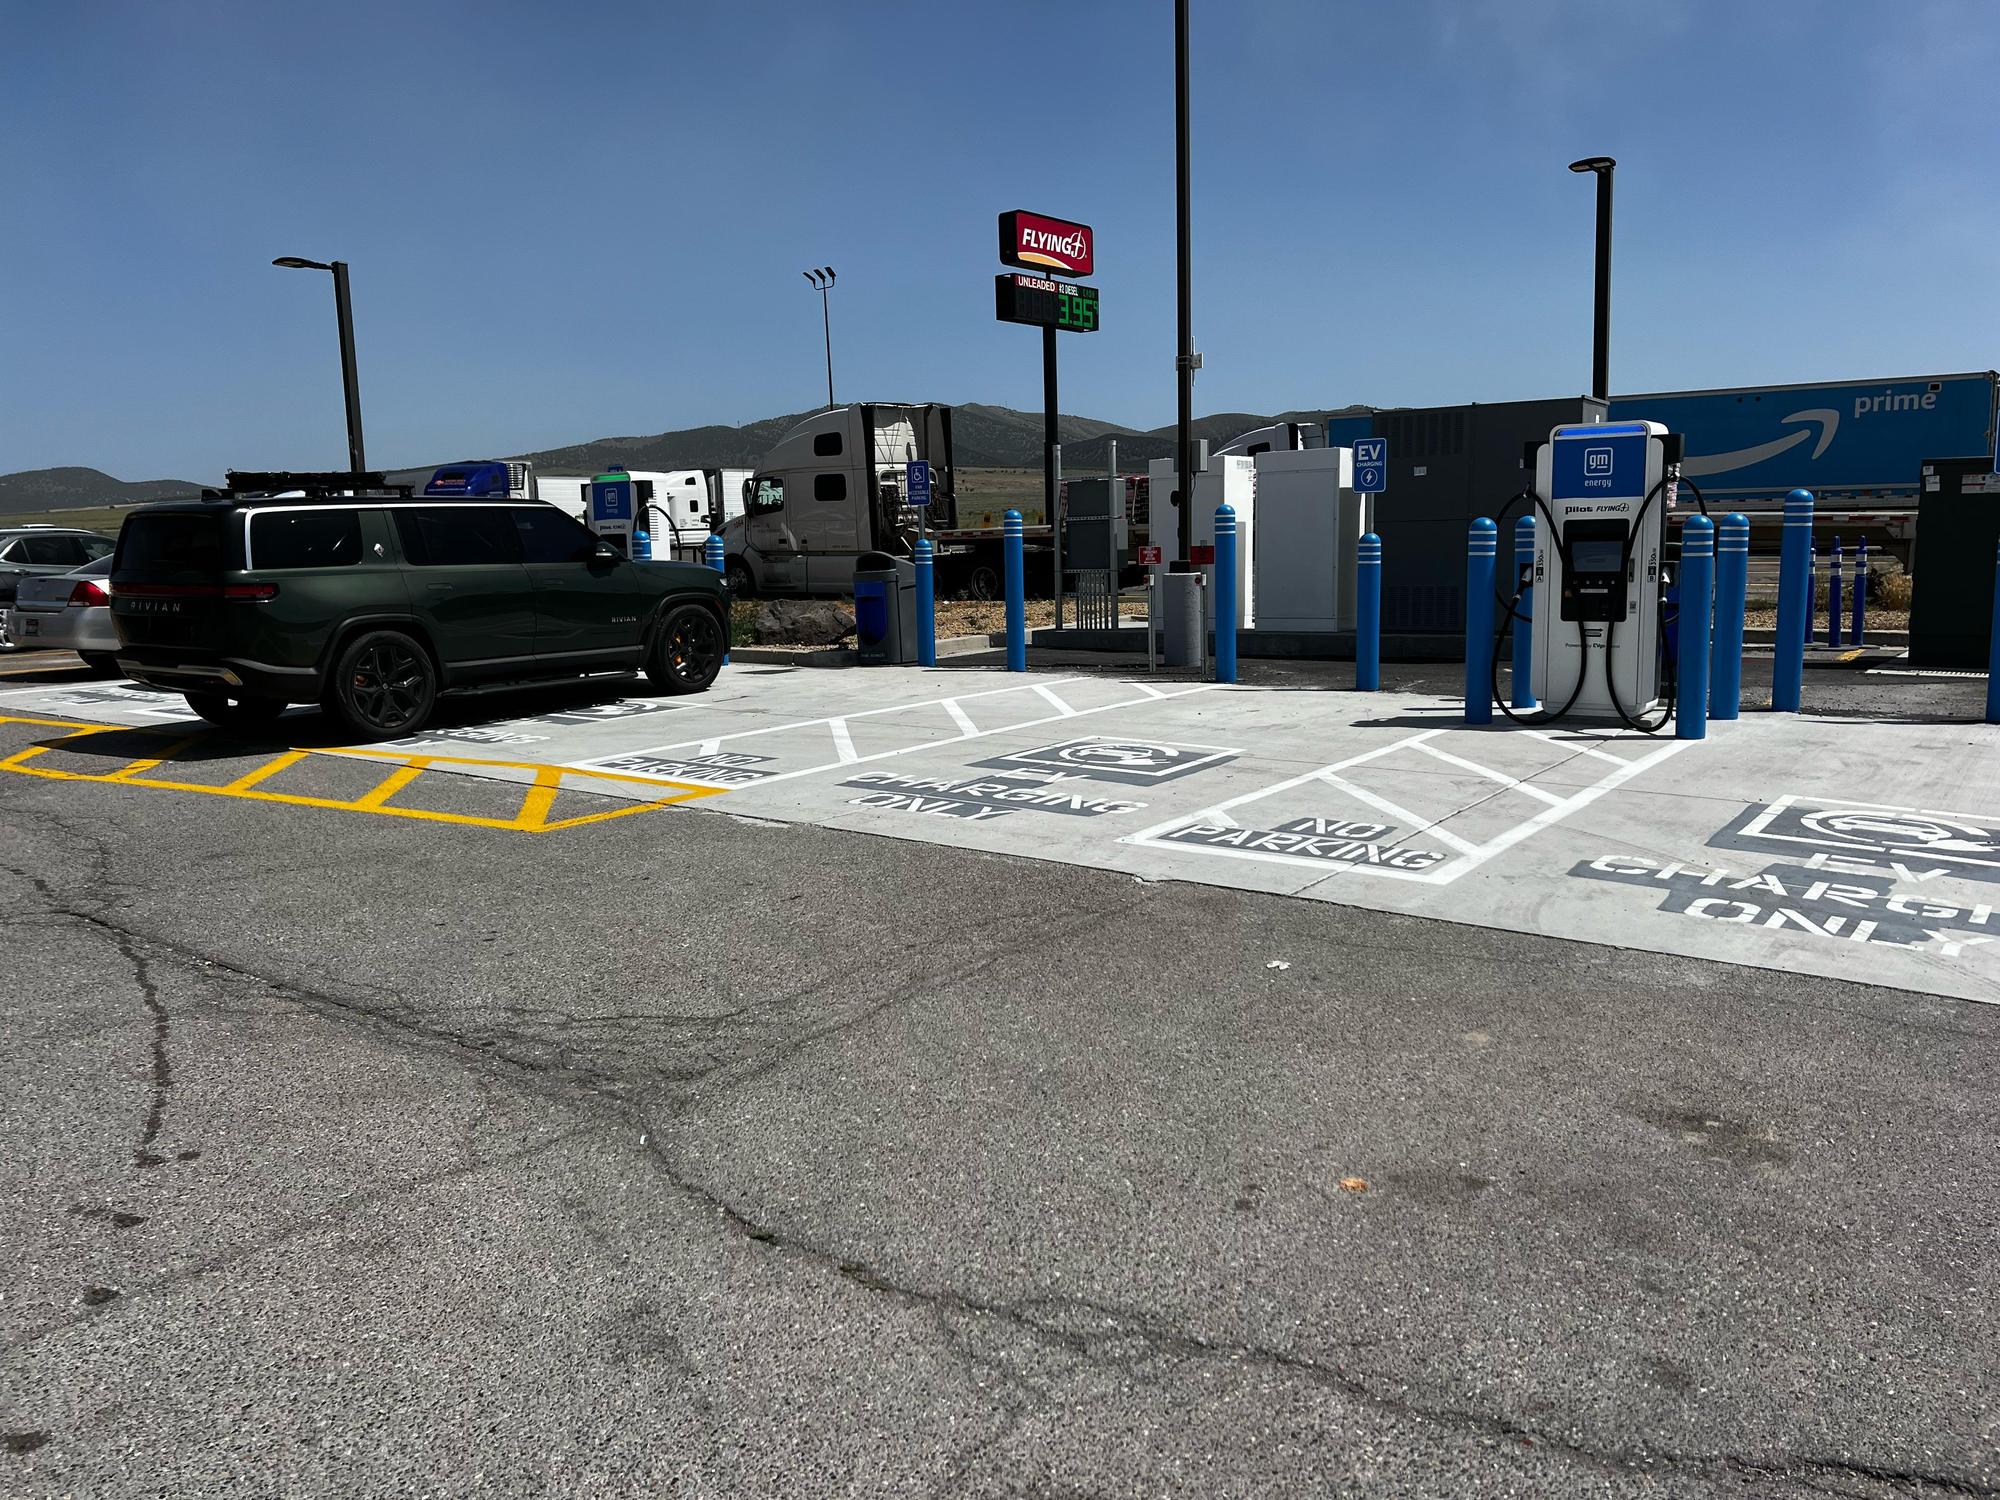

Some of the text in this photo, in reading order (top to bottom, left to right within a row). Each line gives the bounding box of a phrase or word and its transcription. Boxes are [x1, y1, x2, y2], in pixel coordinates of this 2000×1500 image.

[1022, 228, 1070, 255] FLYING
[1018, 276, 1056, 292] UNLEADED
[1065, 284, 1078, 296] DIESEL
[1854, 389, 1937, 418] prime
[1358, 444, 1381, 461] EV
[1584, 479, 1612, 488] energy
[130, 601, 181, 613] RIVIAN
[611, 757, 763, 783] PARKING
[690, 753, 762, 766] NO
[995, 767, 1092, 783] EV
[846, 771, 1150, 814] CHARGING
[848, 793, 1019, 820] ONLY
[1291, 818, 1387, 839] NO
[1168, 824, 1448, 869] PARKING
[1803, 852, 1952, 883] EV
[1683, 897, 1995, 956] ONLY
